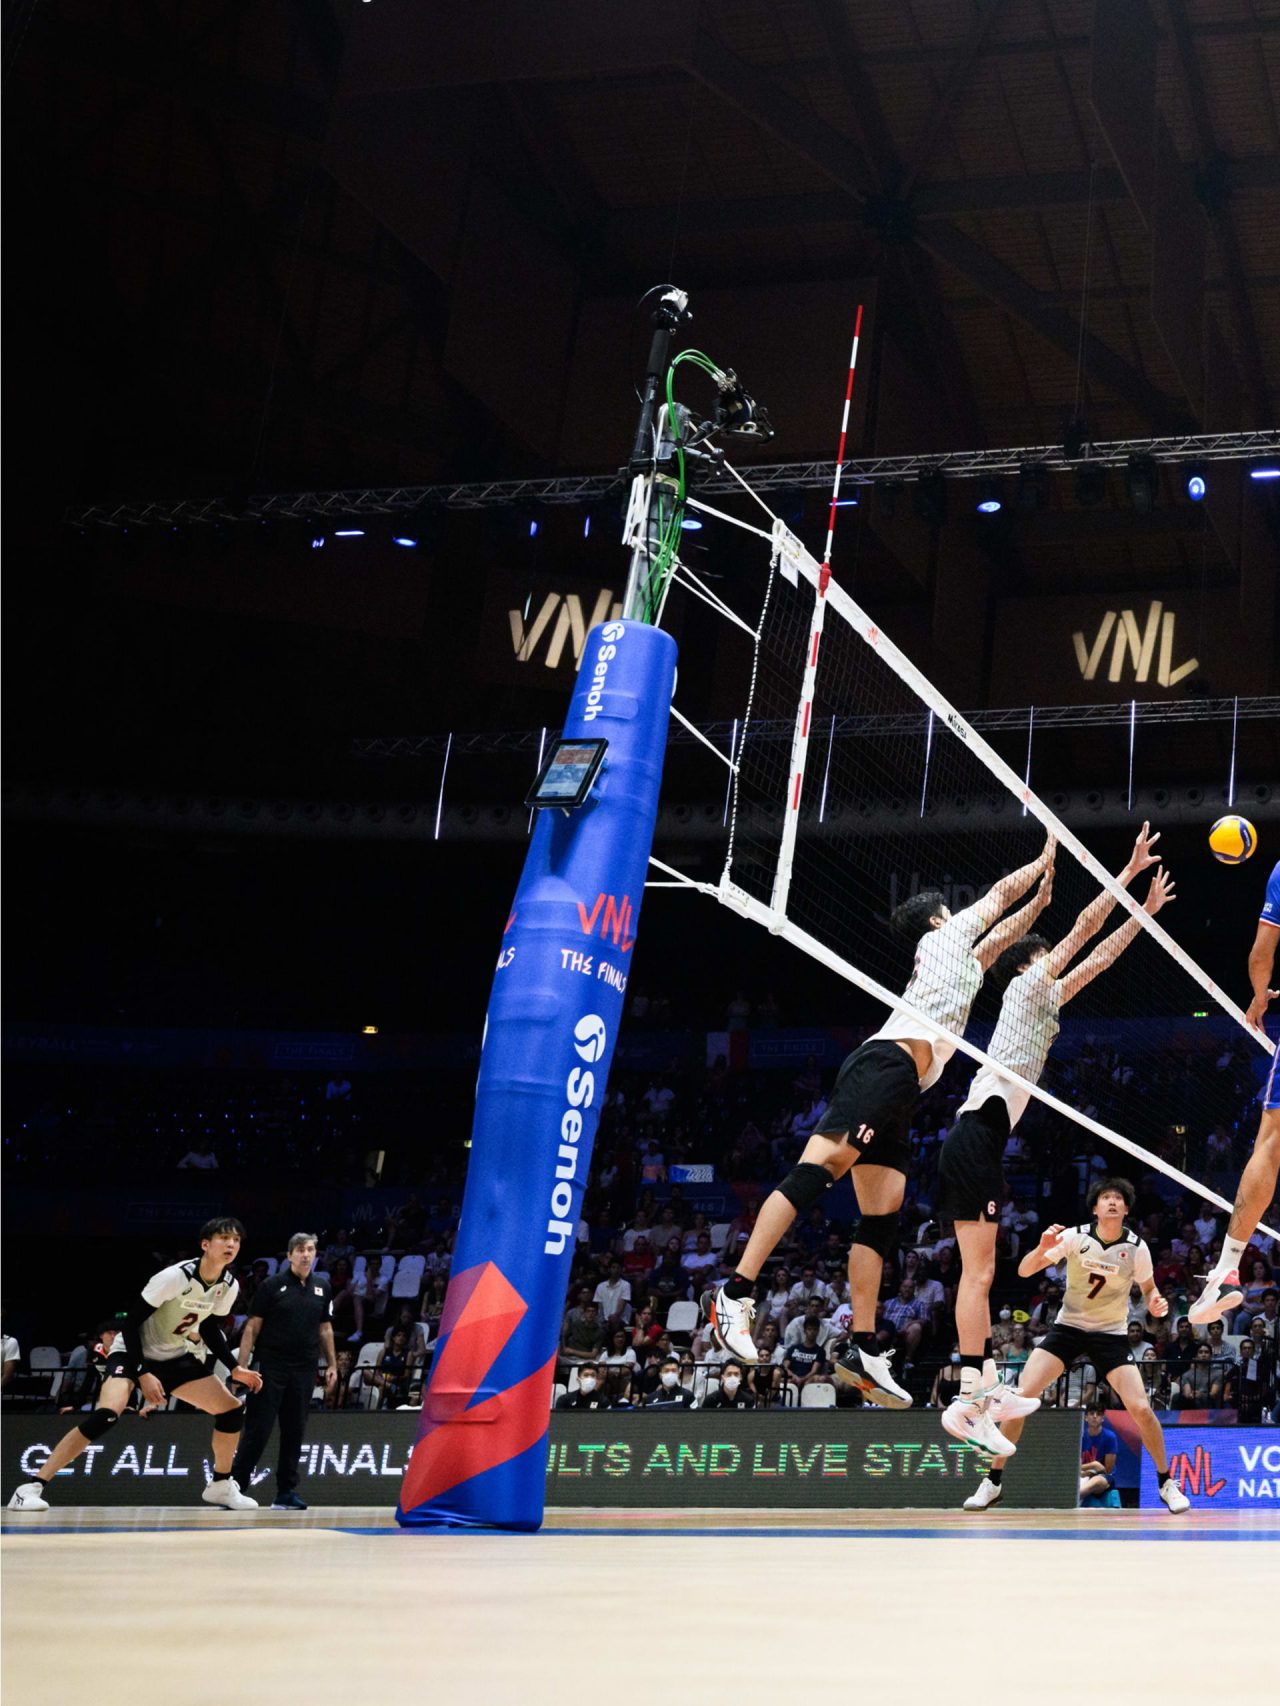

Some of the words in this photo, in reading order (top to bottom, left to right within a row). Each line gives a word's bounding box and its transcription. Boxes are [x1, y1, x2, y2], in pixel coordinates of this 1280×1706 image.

[508, 588, 623, 672] VN
[1072, 600, 1200, 688] VNL
[583, 644, 617, 721] Senoh
[577, 892, 635, 954] VNL
[561, 948, 594, 976] THE
[855, 1122, 876, 1145] 16
[543, 1066, 596, 1256] Senoh
[986, 1200, 997, 1216] 6
[1087, 1272, 1106, 1300] 7
[172, 1312, 199, 1336] 2
[114, 1365, 125, 1375] 2
[111, 1444, 190, 1476] ALL
[642, 1443, 741, 1477] AND
[752, 1443, 849, 1477] LIVE
